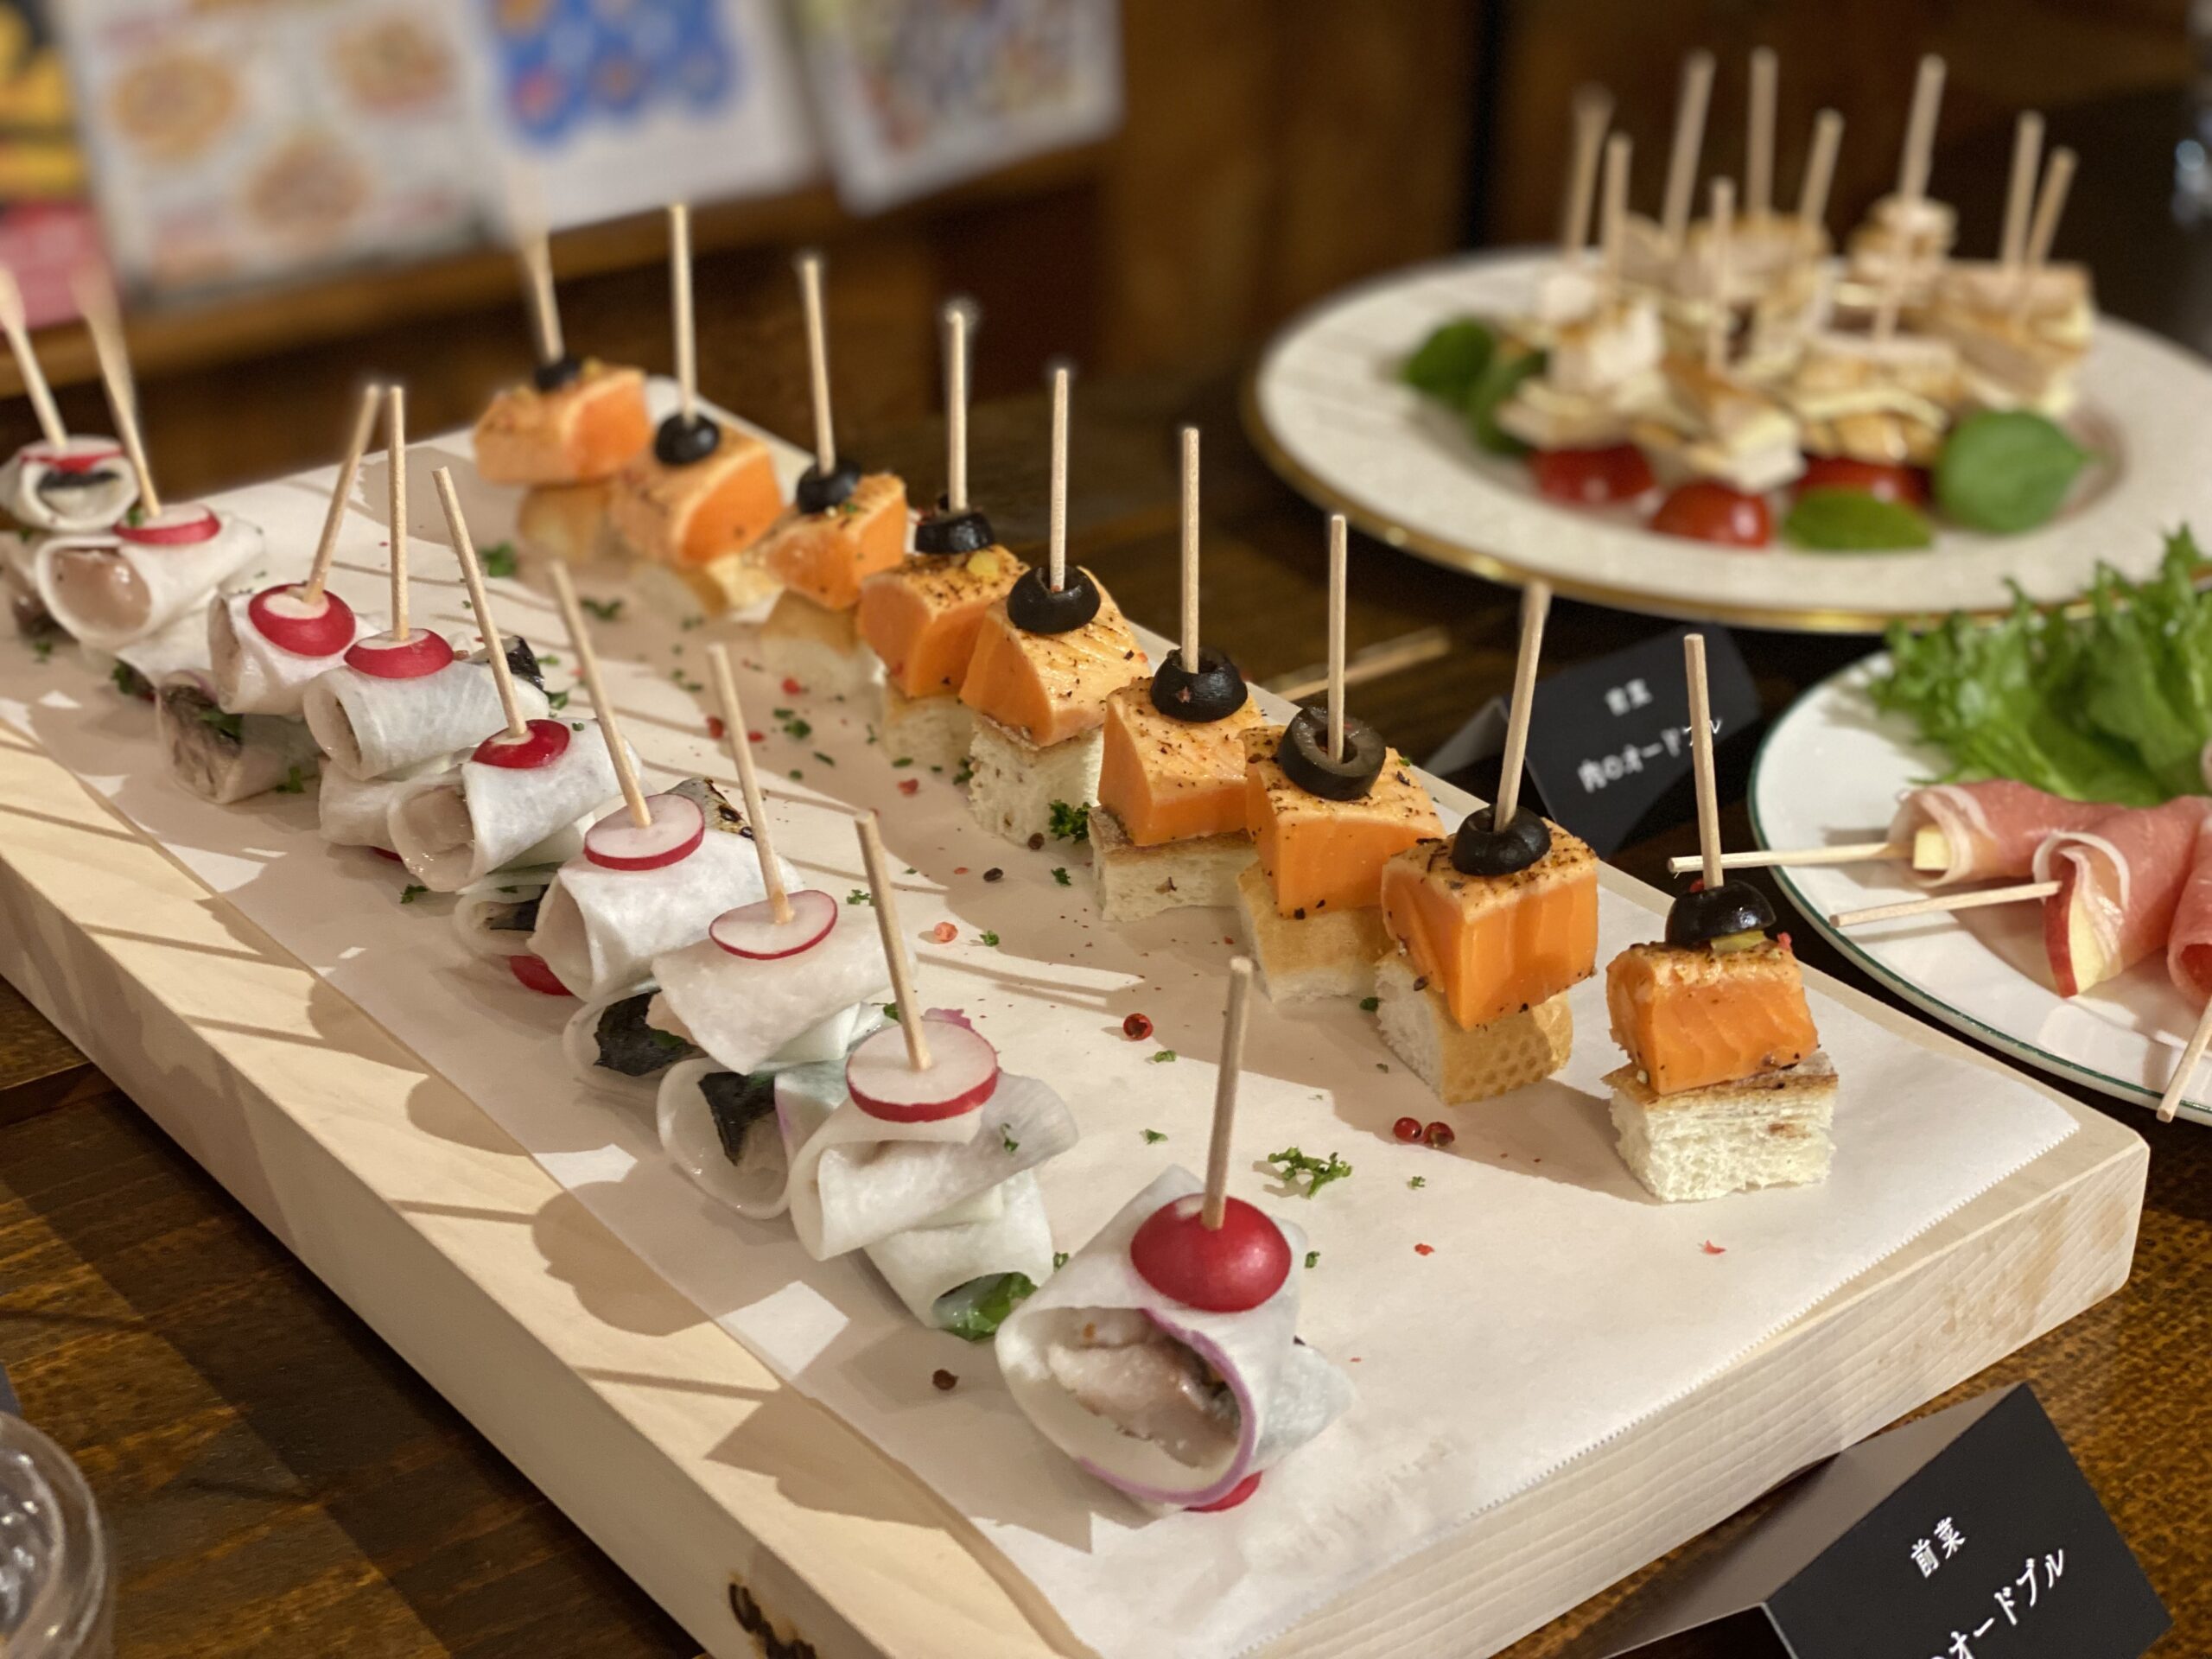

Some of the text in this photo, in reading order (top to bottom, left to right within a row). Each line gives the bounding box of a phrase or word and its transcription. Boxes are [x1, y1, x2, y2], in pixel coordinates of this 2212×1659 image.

[1910, 1516, 1966, 1579] 前菜
[1930, 1548, 2063, 1659] オードブル
